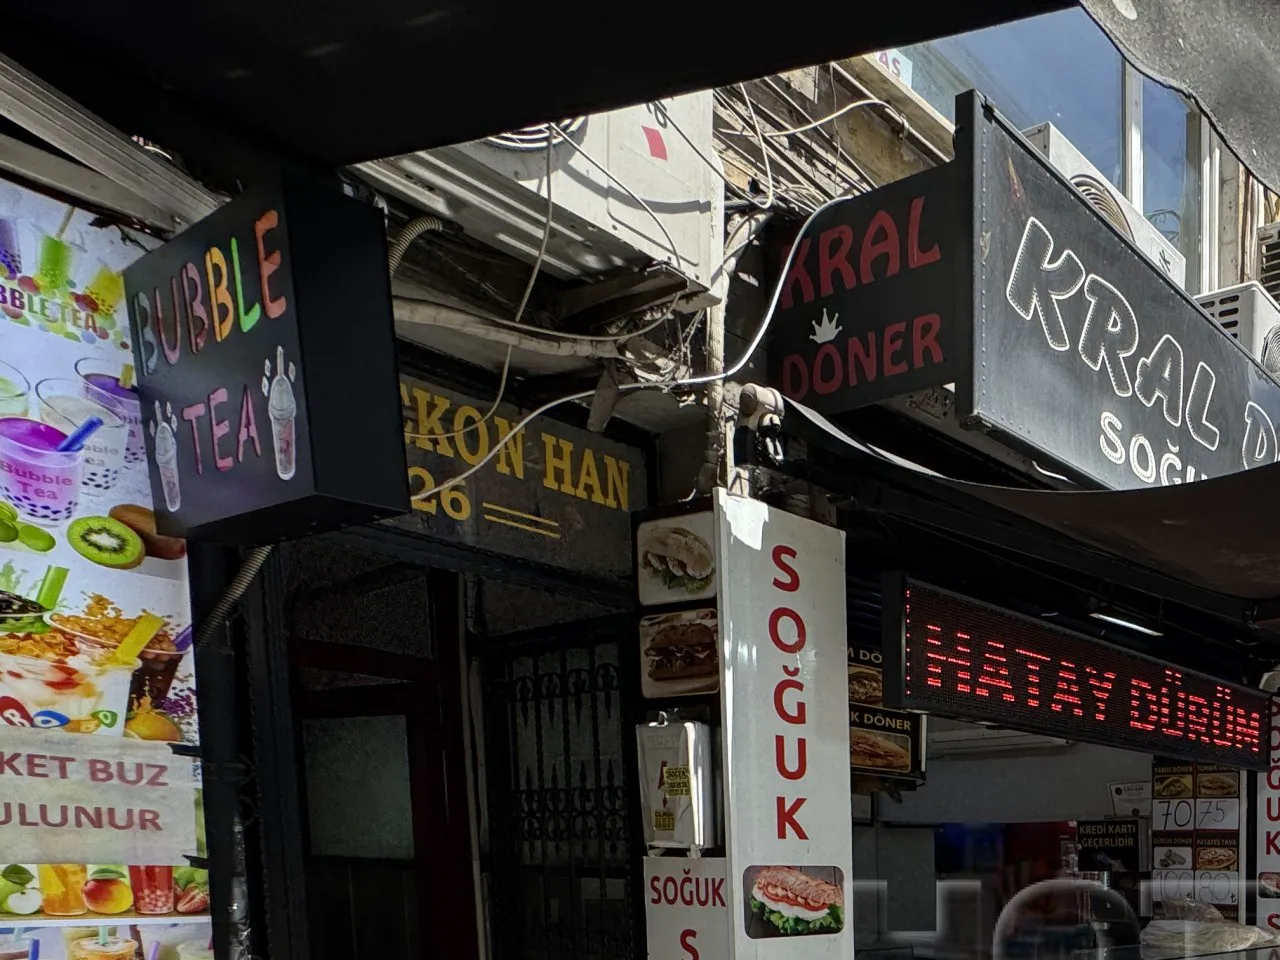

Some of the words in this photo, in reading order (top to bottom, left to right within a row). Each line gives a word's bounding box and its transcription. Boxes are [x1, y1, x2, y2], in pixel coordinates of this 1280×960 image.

[780, 195, 942, 312] KRAL
[133, 209, 288, 377] BUBBLE
[56, 302, 99, 334] TEA
[1006, 216, 1222, 450] KRAL
[182, 383, 264, 476] TEA
[18, 480, 58, 501] Tea
[408, 466, 472, 521] 26
[541, 431, 632, 513] HAN
[768, 544, 810, 842] SOĞUK
[926, 624, 1117, 722] HATAY
[1130, 668, 1261, 752] DÜRÜM
[864, 713, 912, 731] DÖNER
[88, 759, 169, 787] BUZ
[1080, 823, 1106, 835] KREDİ
[1108, 824, 1136, 834] KARTI
[1158, 800, 1193, 830] 70
[1198, 800, 1225, 828] 75
[1081, 836, 1134, 849] GEÇERLİDİR
[650, 868, 727, 907] SOĞUK
